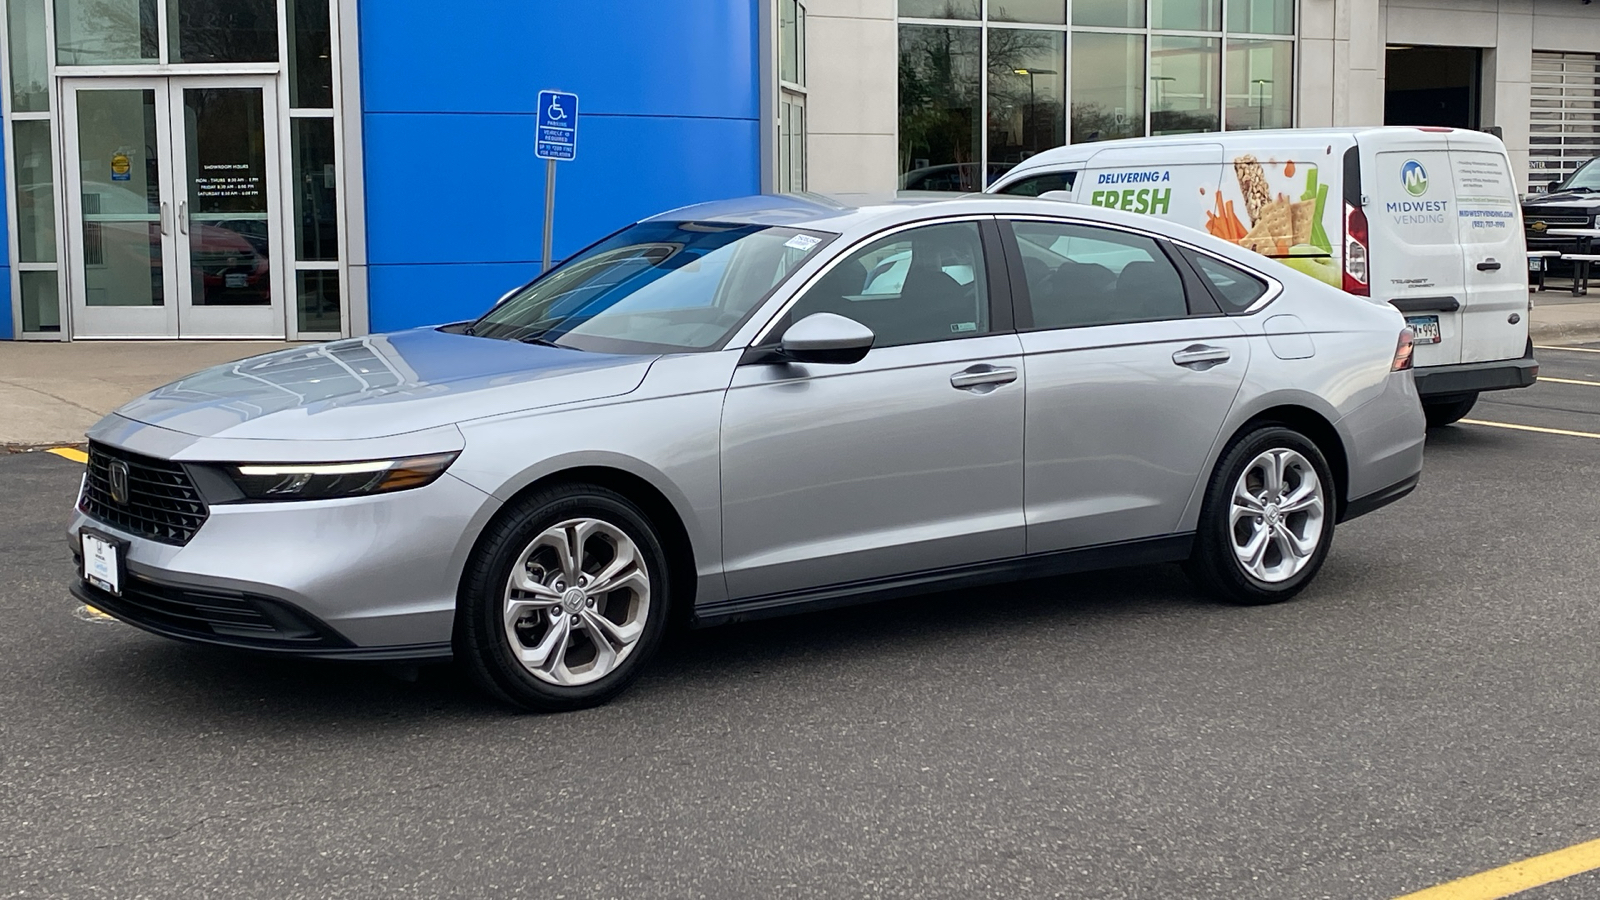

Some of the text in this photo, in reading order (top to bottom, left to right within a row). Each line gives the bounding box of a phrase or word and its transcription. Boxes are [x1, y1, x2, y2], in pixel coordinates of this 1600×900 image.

[1098, 171, 1170, 184] DELIVERING A
[1092, 188, 1171, 214] FRESH
[1386, 201, 1447, 213] MIDWEST
[1394, 214, 1444, 224] VENDING
